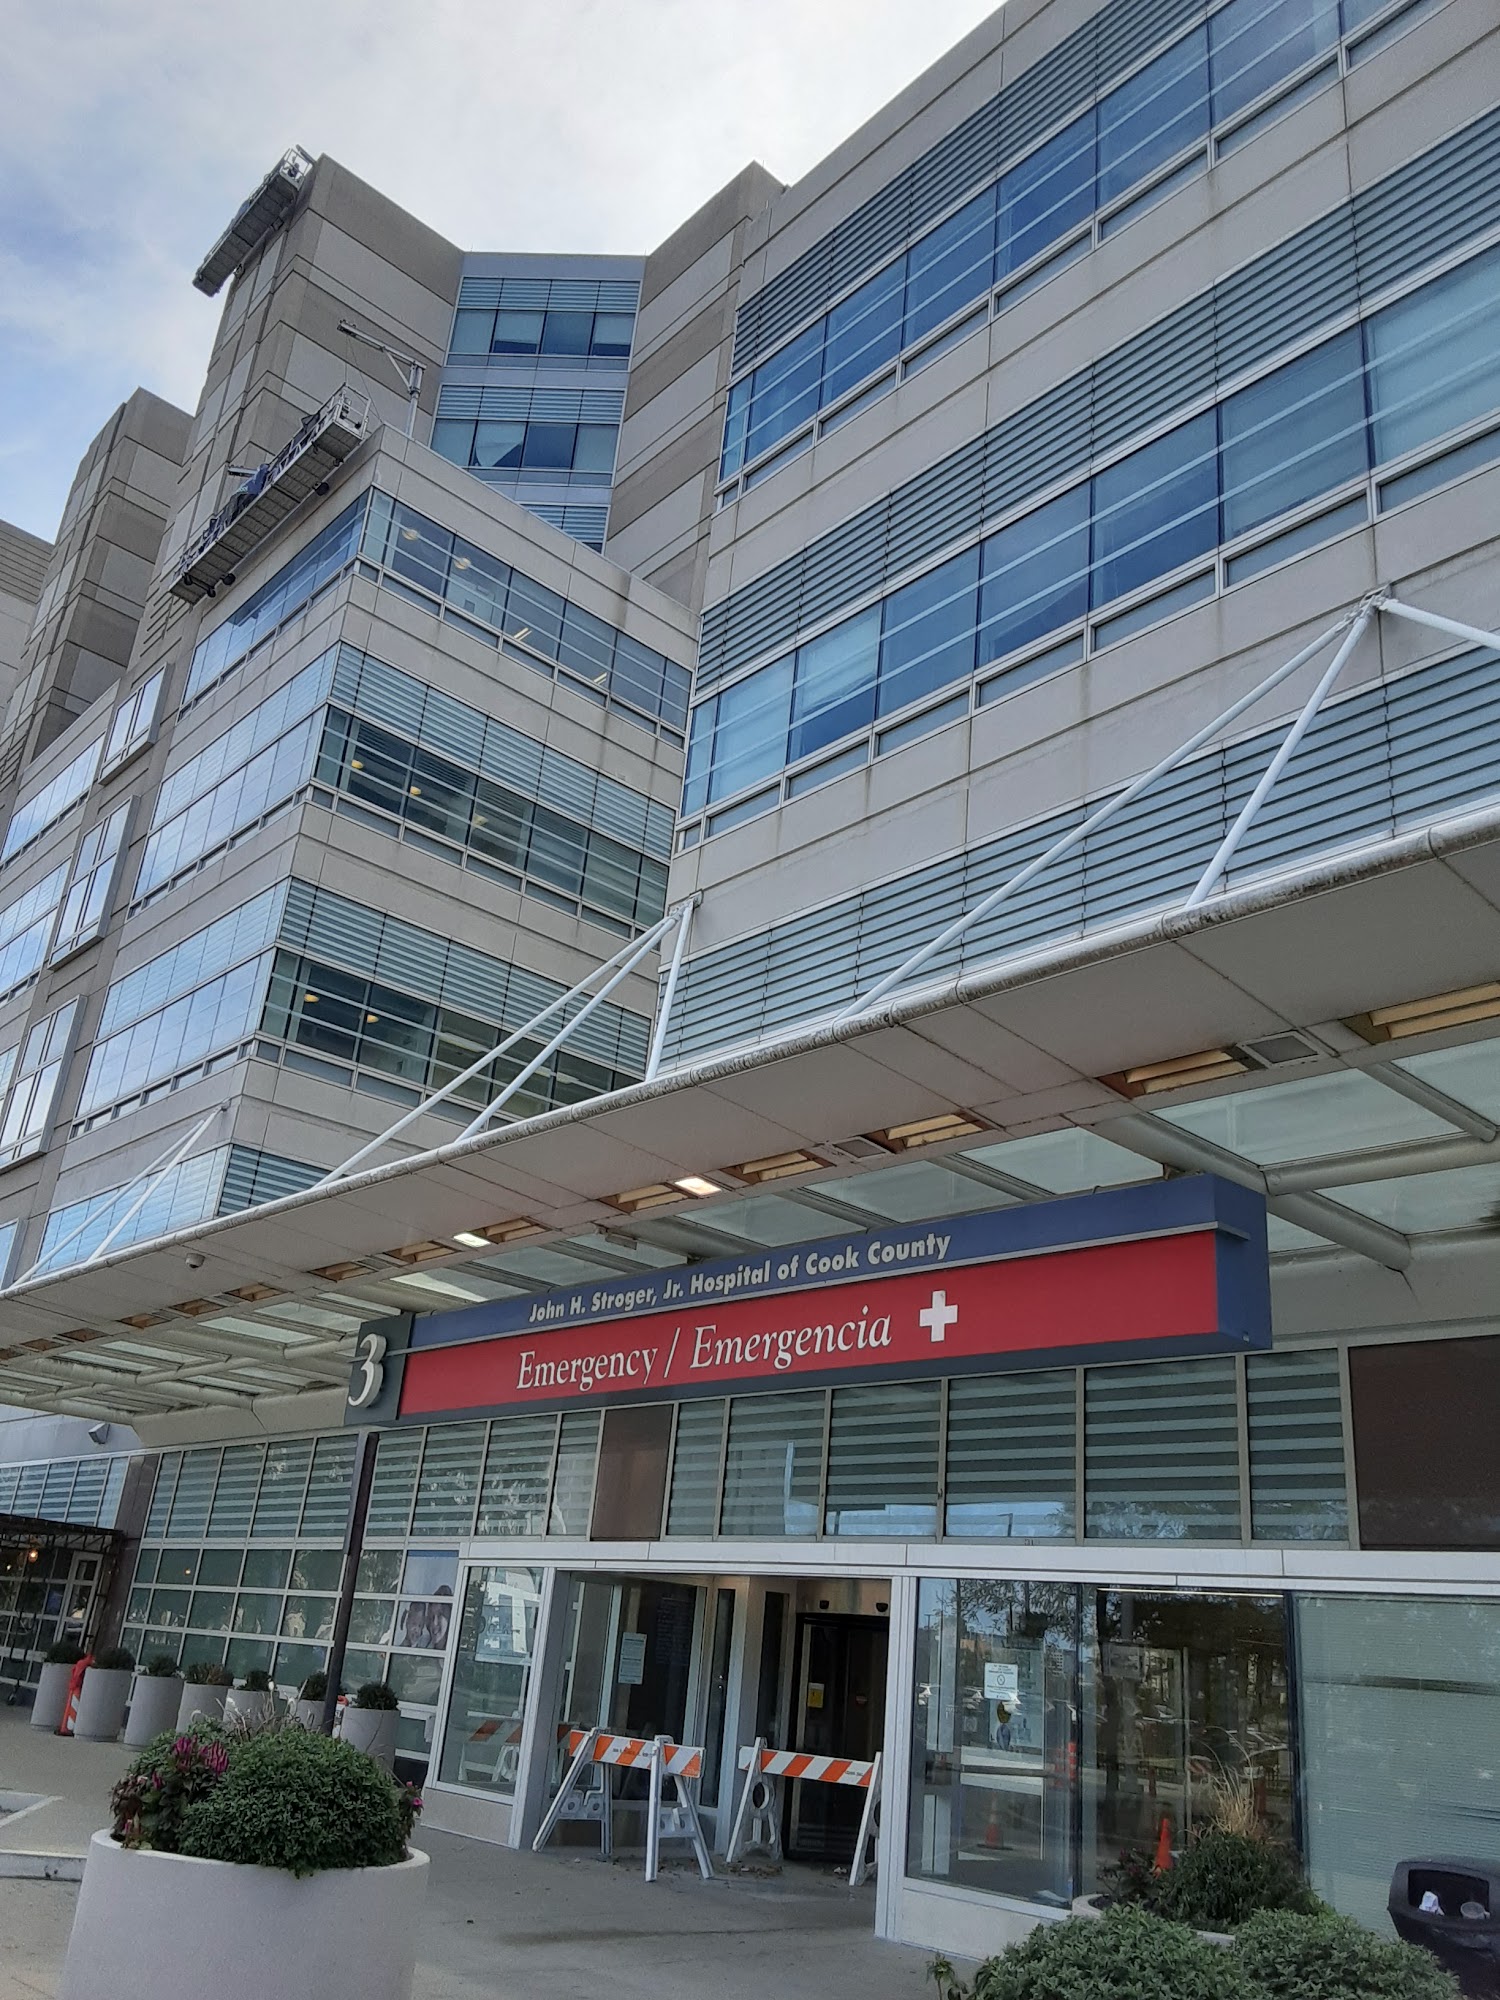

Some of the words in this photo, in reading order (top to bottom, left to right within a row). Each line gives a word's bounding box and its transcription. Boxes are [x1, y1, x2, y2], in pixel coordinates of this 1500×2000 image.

[529, 1302, 564, 1322] John
[570, 1296, 586, 1315] H.
[591, 1287, 657, 1312] Stroger,
[662, 1279, 683, 1299] Jr.
[690, 1260, 770, 1294] Hospital
[777, 1258, 799, 1279] of
[806, 1245, 859, 1274] Cook
[868, 1233, 951, 1264] County
[348, 1333, 387, 1408] 3
[516, 1347, 658, 1392] Emergency
[690, 1305, 892, 1370] Emergencia
